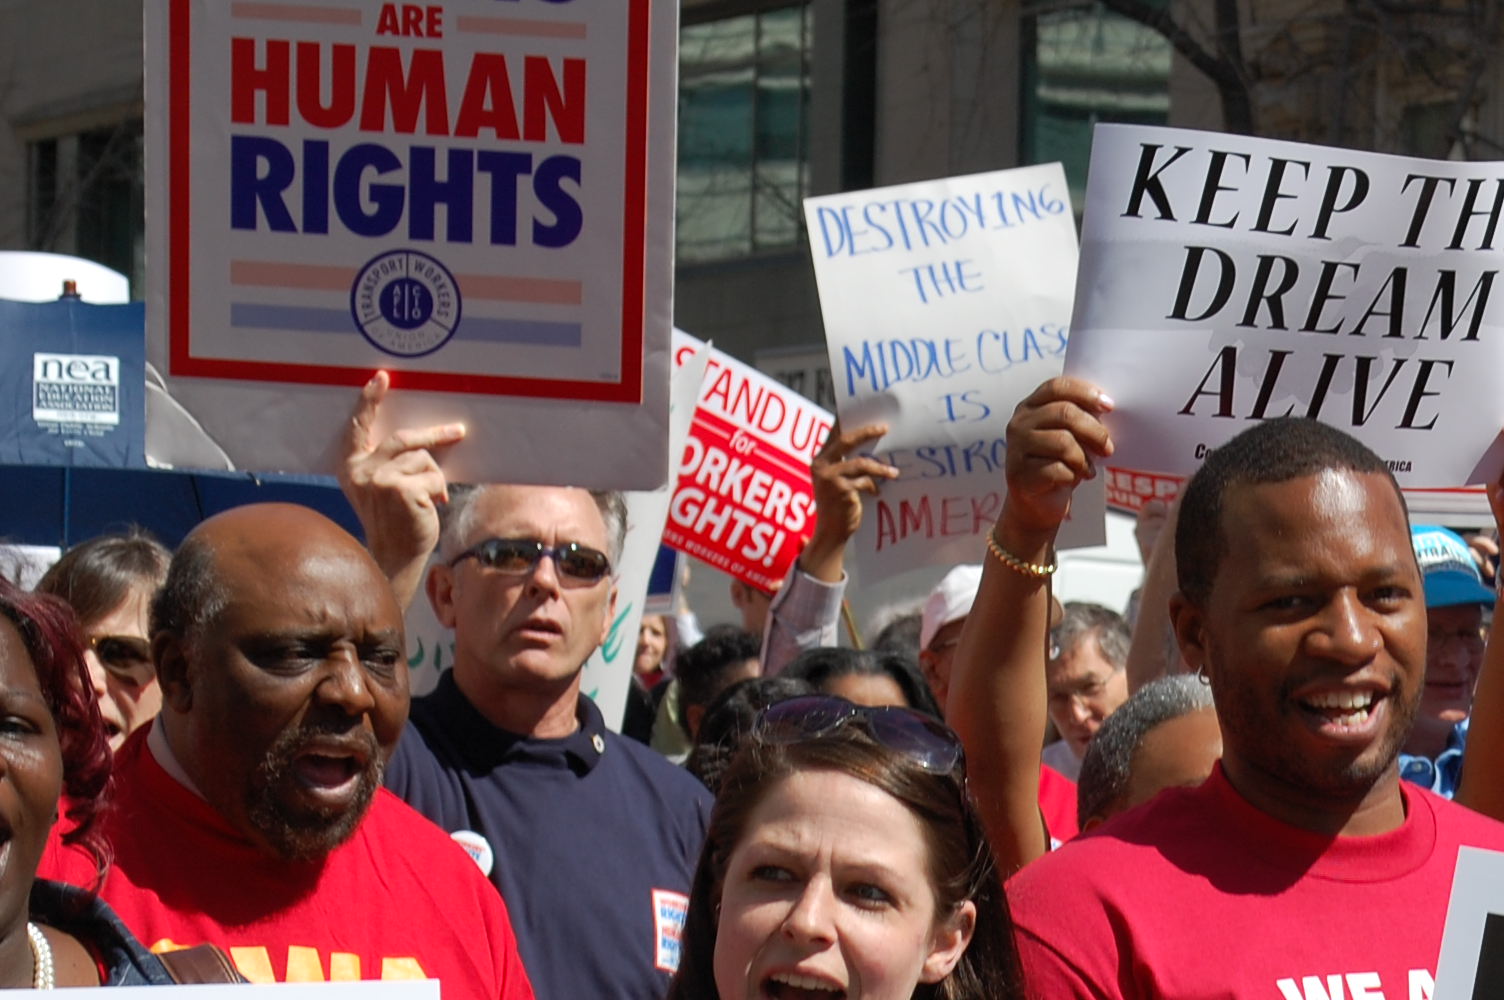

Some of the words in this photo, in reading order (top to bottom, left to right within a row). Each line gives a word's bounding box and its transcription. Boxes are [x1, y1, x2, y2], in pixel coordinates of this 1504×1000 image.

[376, 3, 443, 39] ARE
[231, 37, 586, 144] HUMAN
[231, 134, 583, 249] RIGHTS
[816, 183, 1065, 259] DESTROYING
[1119, 142, 1371, 241] KEEP
[361, 257, 404, 318] TRANSPORT
[414, 258, 451, 318] WORKERS
[898, 258, 985, 304] THE
[1165, 245, 1499, 341] DREAM
[42, 358, 112, 382] nea
[842, 338, 972, 397] MIDDLE
[1177, 345, 1455, 430] ALIVE
[935, 389, 991, 424] IS
[729, 427, 757, 456] for
[1385, 459, 1413, 473] RICA
[678, 435, 817, 533] ORKERS'
[670, 486, 786, 568] GHTS!
[875, 491, 1072, 551] AMER
